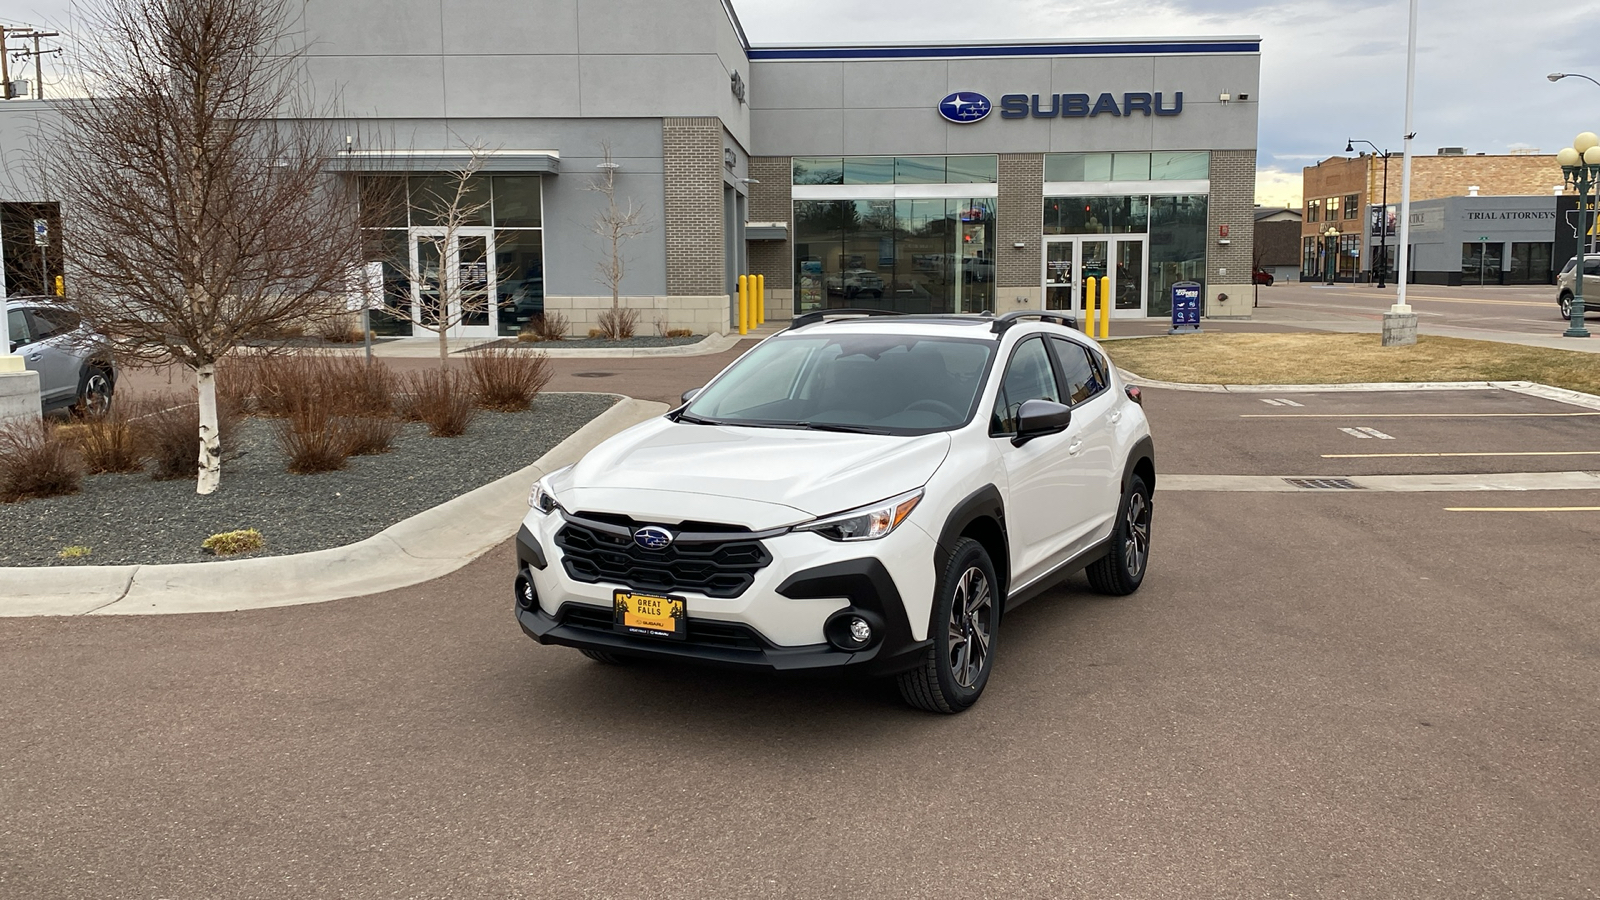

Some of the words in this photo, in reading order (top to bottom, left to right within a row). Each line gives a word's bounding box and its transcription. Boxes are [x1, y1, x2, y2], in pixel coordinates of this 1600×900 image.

[1001, 91, 1183, 119] SUBARU
[1468, 212, 1497, 220] TRIAL
[1499, 211, 1556, 220] ATTORNEYS
[638, 599, 661, 608] GREAT
[638, 606, 661, 615] FALLS
